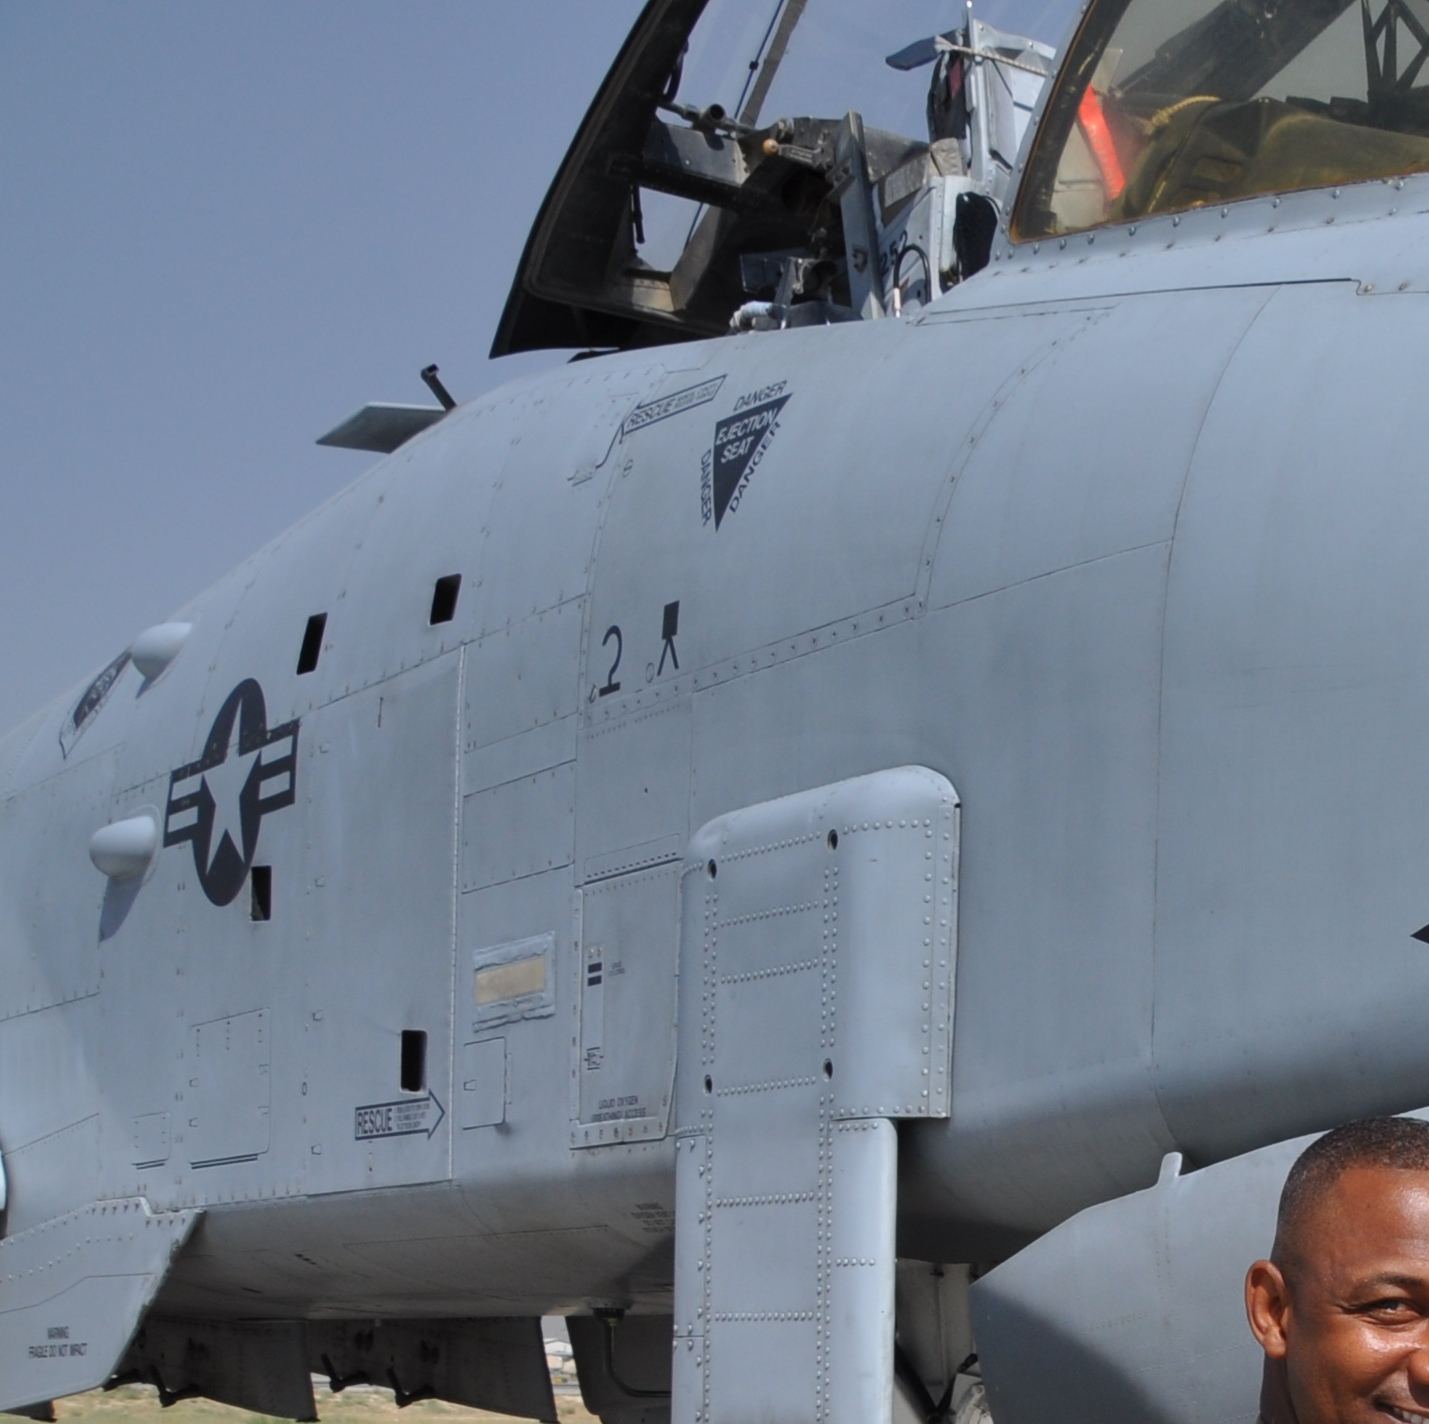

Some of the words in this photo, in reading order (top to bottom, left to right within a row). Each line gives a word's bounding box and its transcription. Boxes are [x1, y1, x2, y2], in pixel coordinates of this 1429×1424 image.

[733, 380, 788, 412] DANGER
[716, 408, 778, 446] EJECTION
[720, 436, 755, 464] SEAT
[729, 421, 781, 514] DANGER
[700, 449, 712, 528] DANGER
[599, 625, 622, 697] 2
[357, 1108, 393, 1135] RESCUE
